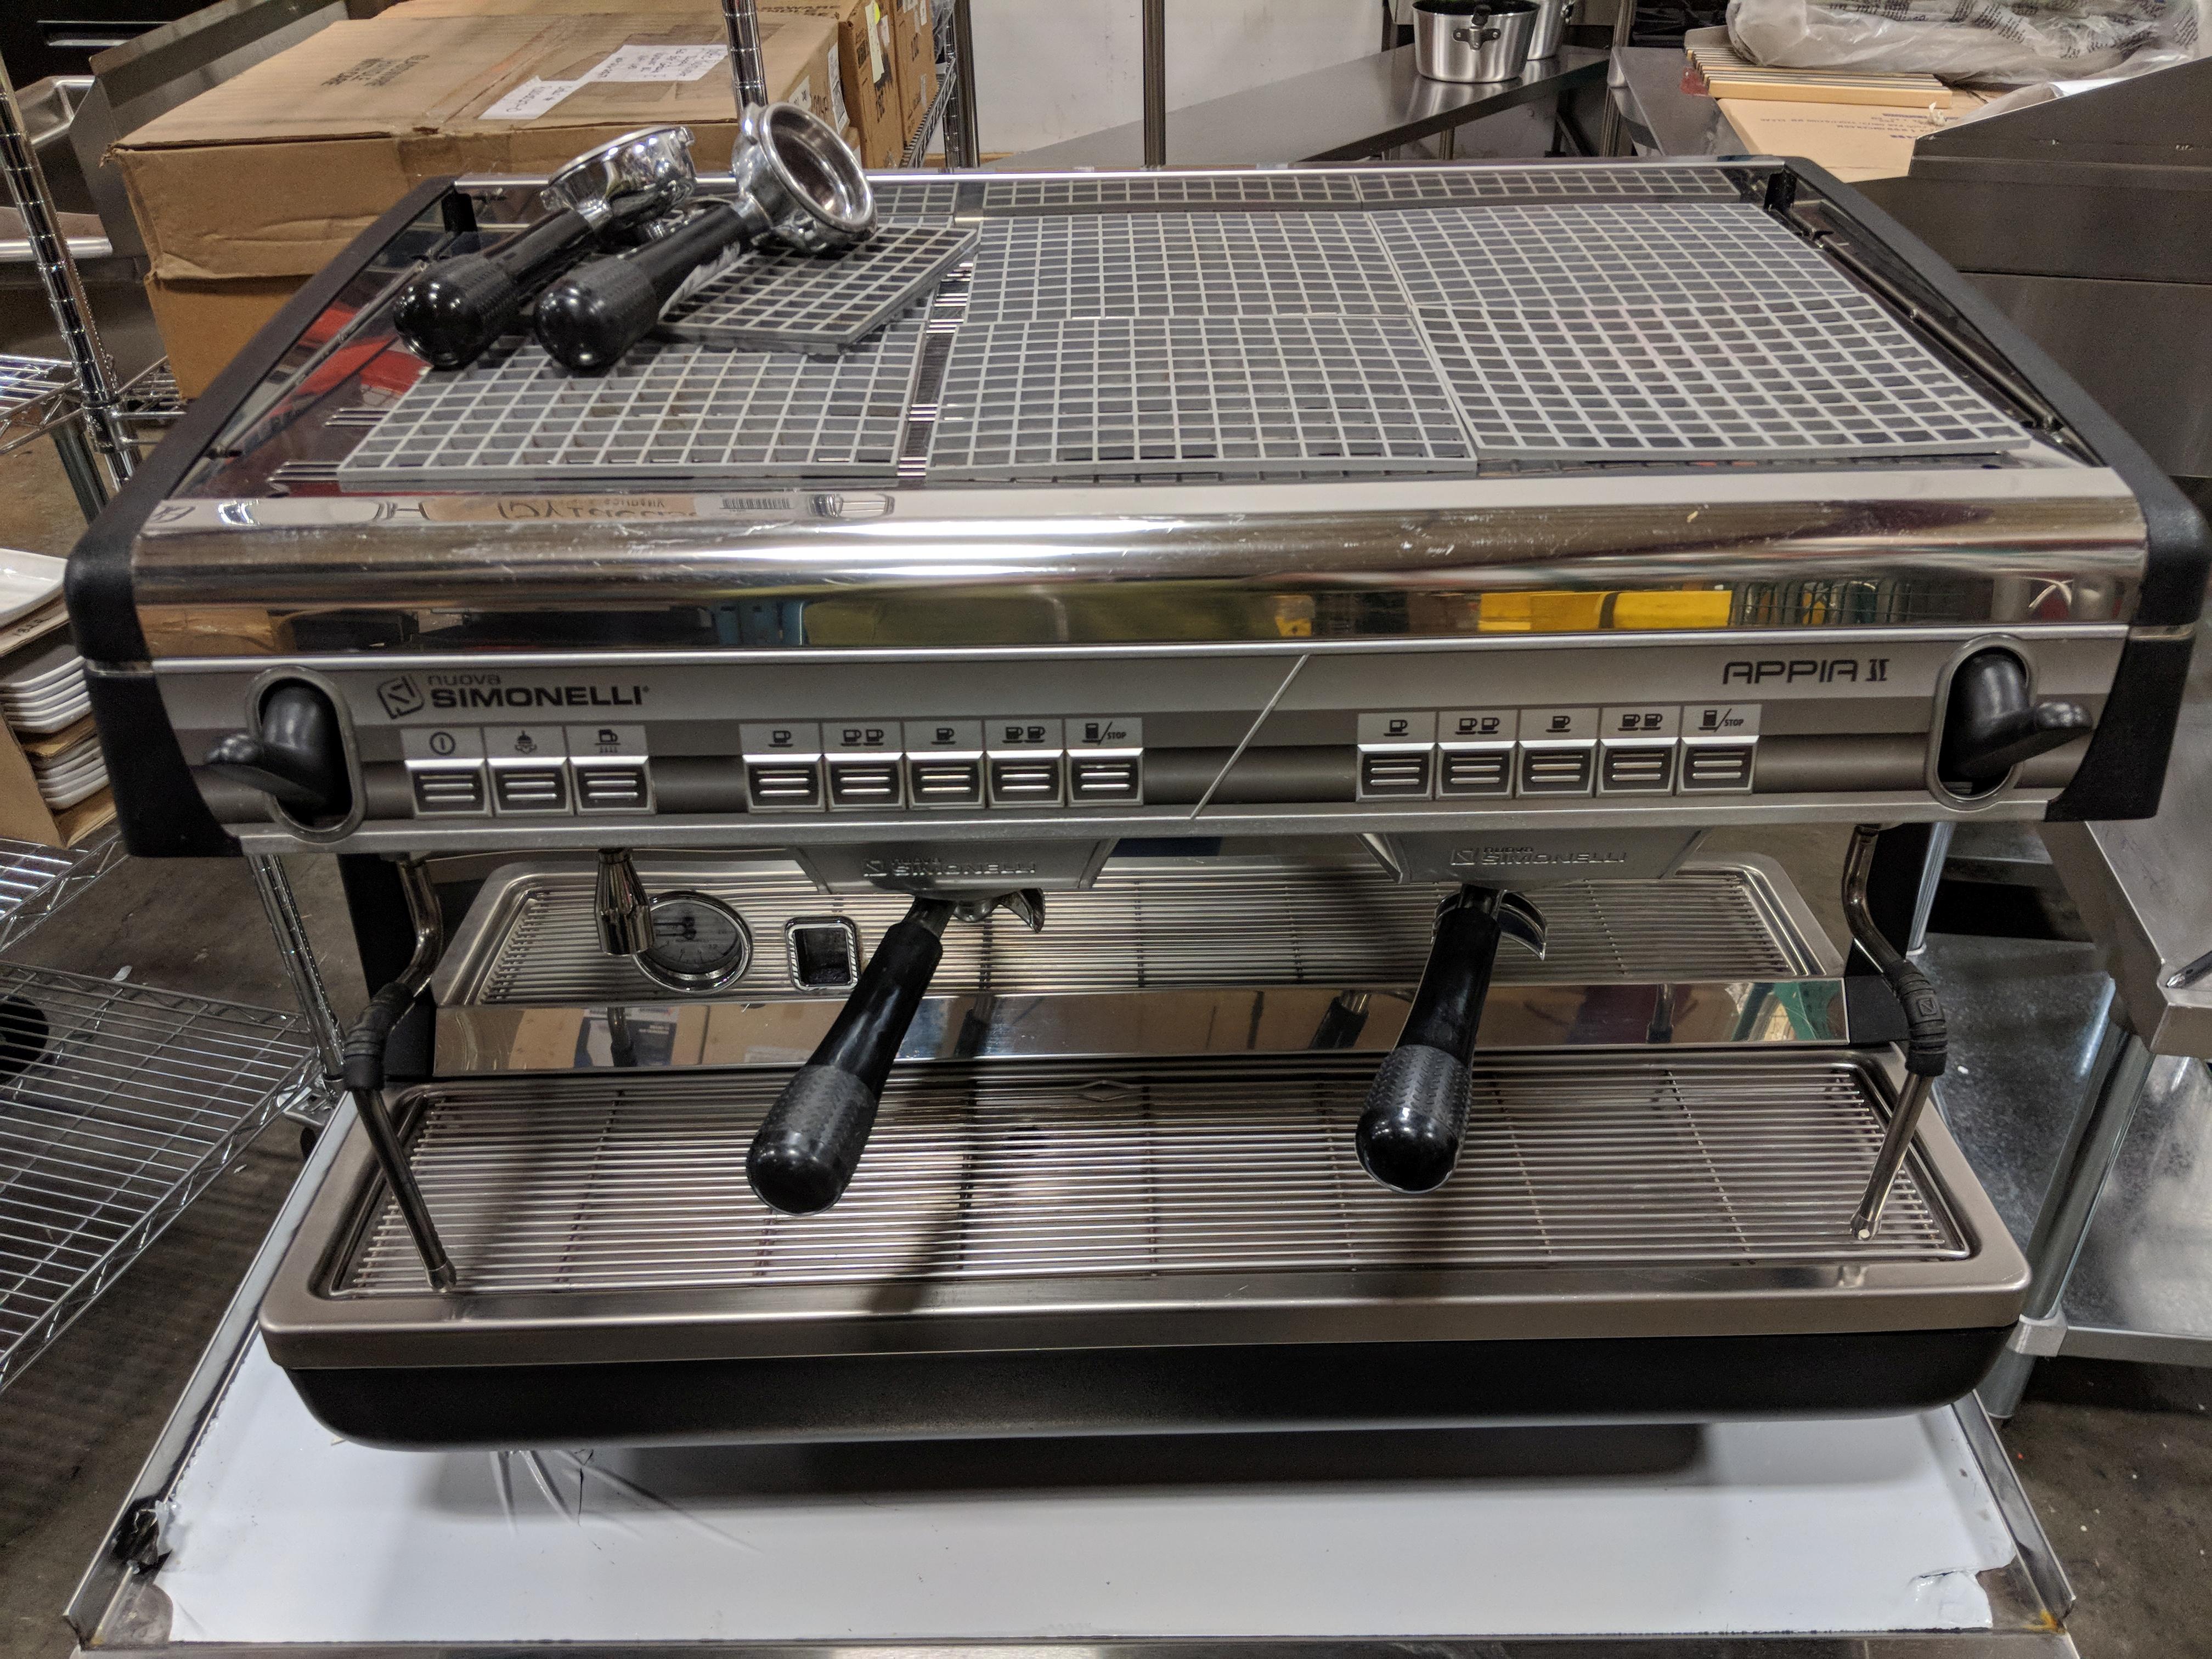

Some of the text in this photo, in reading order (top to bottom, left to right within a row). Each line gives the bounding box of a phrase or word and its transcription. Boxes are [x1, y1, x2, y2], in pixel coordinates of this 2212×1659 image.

[1722, 659, 1859, 685] APPIA
[427, 673, 501, 686] nuova
[431, 685, 642, 709] SIMONELLI
[1482, 852, 1627, 865] SIMONELLI
[893, 863, 1036, 877] SIMONELLI
